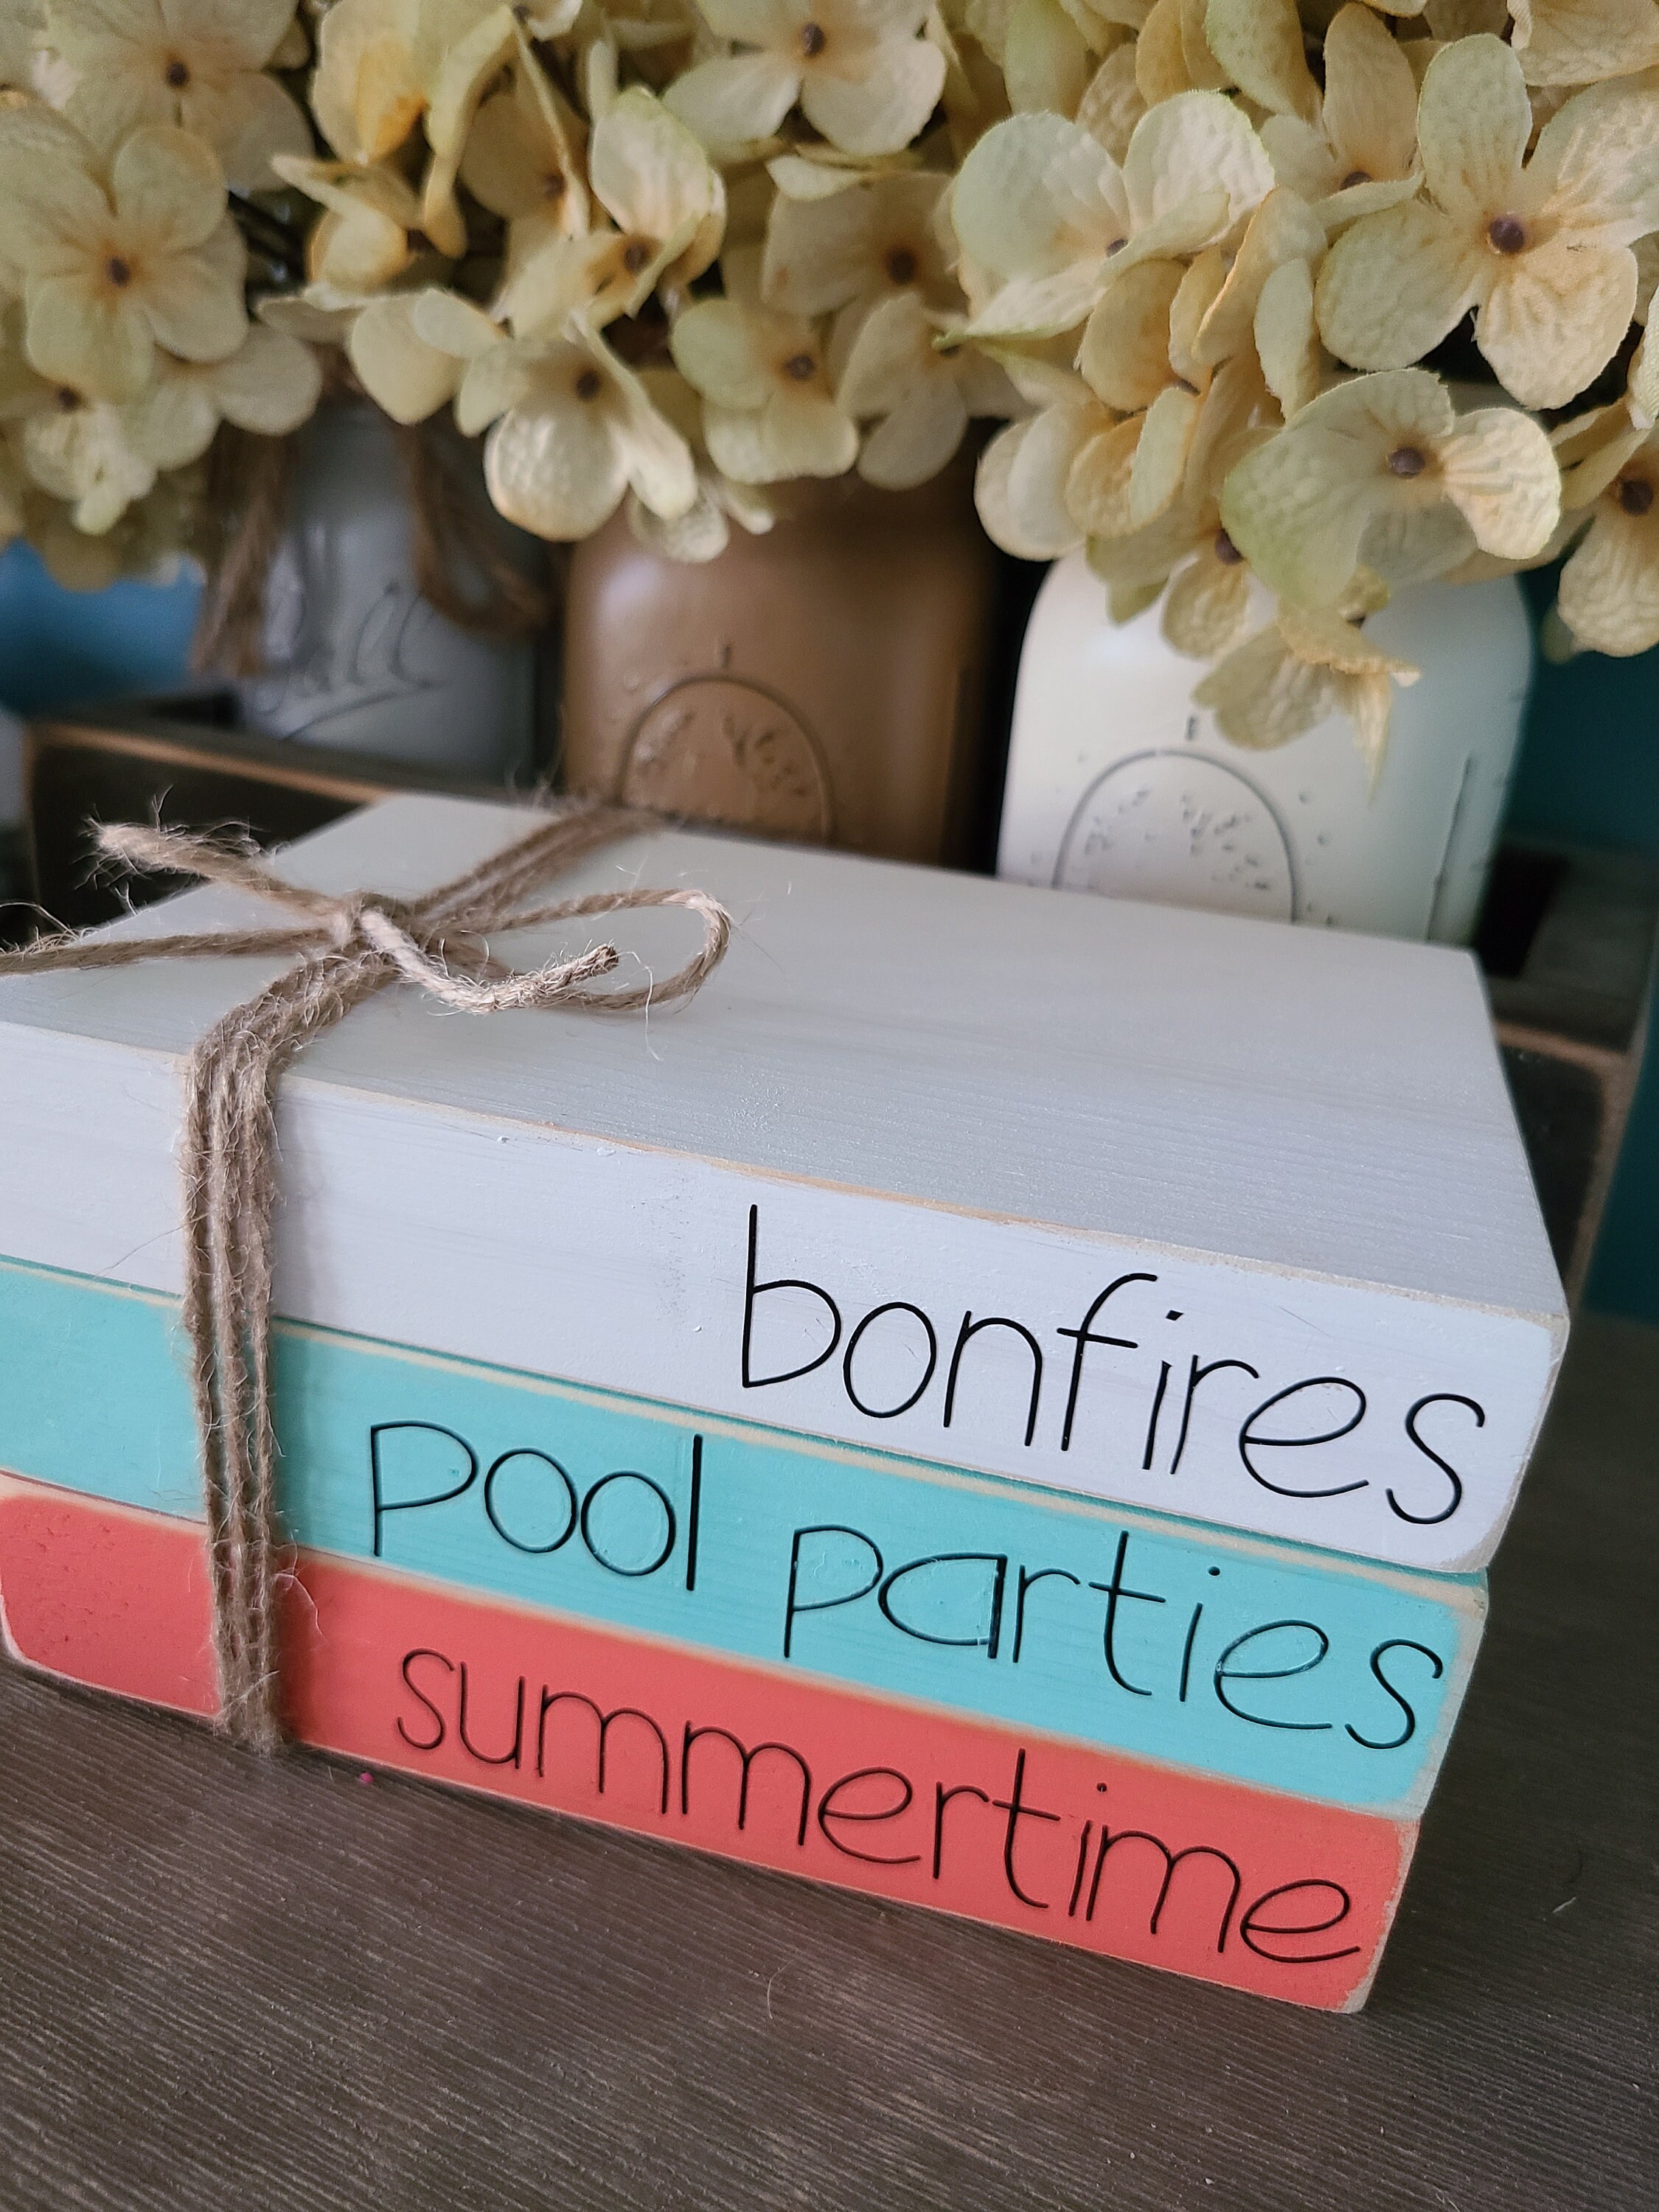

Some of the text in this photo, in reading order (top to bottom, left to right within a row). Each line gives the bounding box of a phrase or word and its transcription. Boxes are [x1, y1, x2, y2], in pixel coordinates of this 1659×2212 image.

[741, 1204, 1486, 1525] bonfires
[370, 1422, 1444, 1750] pool parties
[397, 1648, 1361, 1964] summertime
